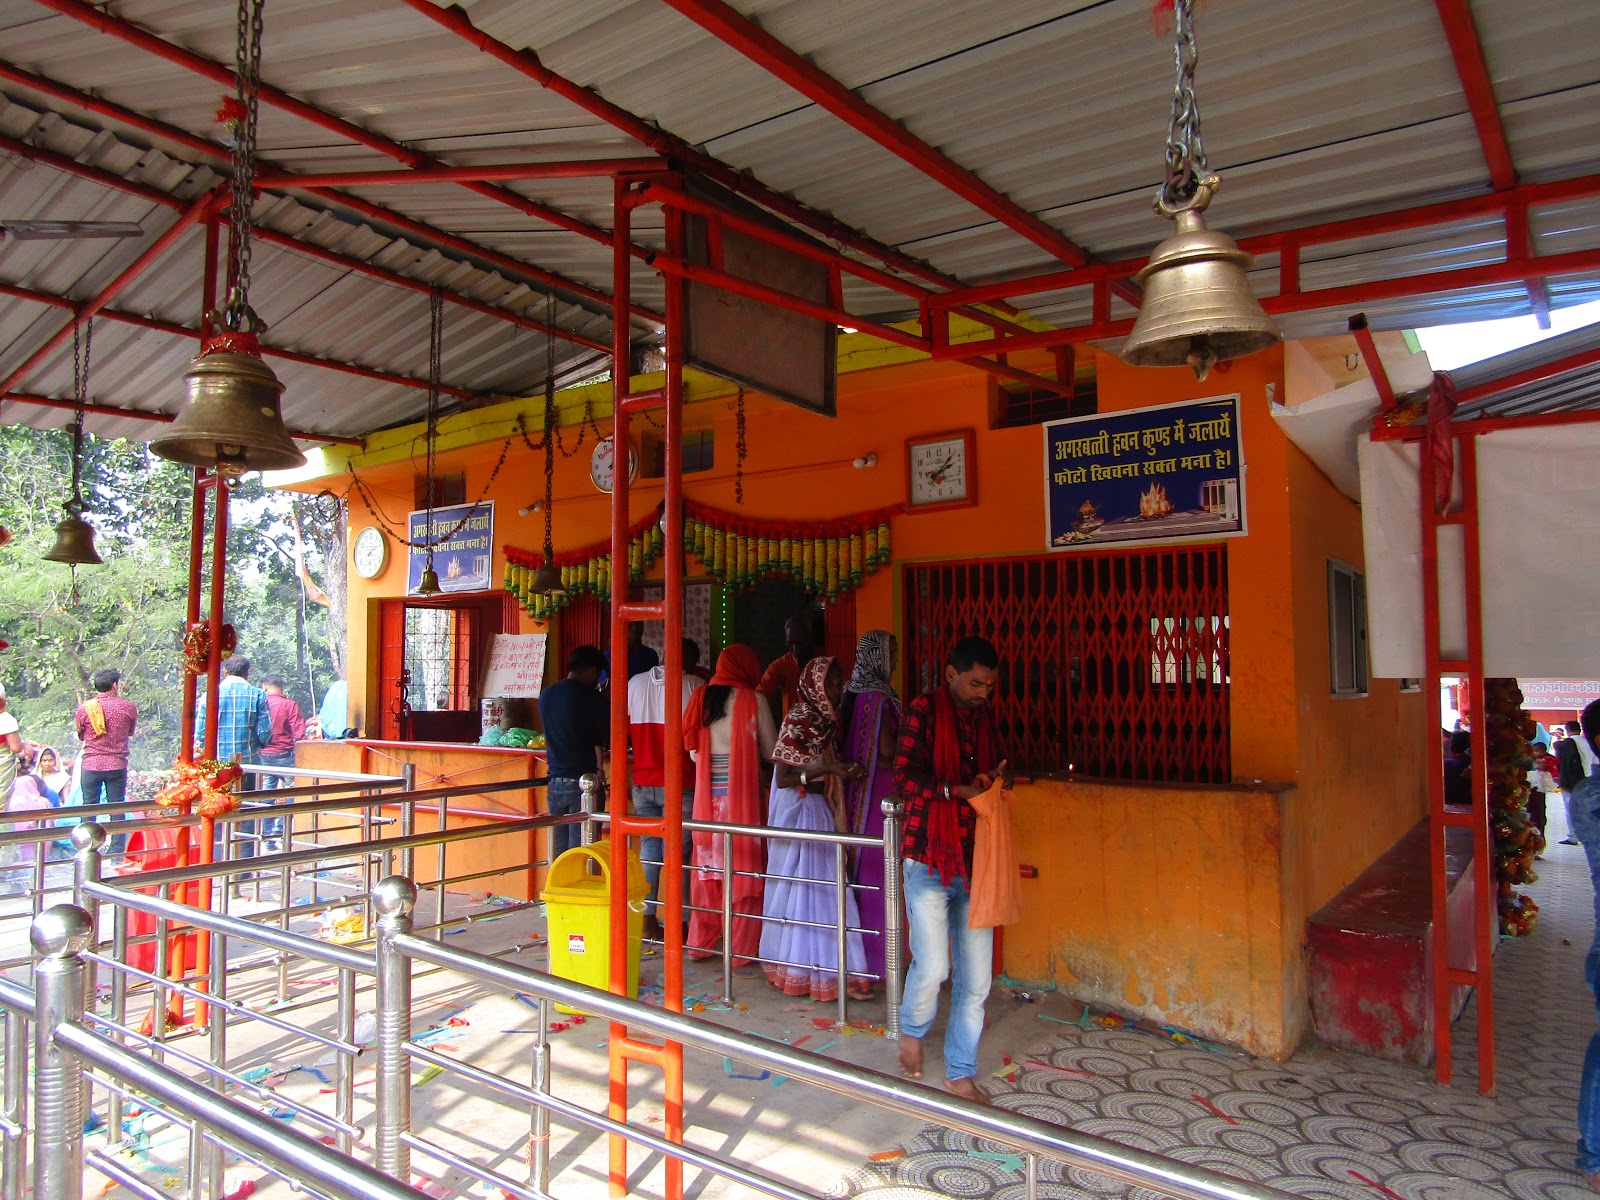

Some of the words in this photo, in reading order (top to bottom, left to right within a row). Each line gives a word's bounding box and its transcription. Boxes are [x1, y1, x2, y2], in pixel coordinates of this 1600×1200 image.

[1055, 430, 1110, 460] अगरबत्ती
[1112, 431, 1140, 457] हवन
[1142, 426, 1170, 456] कुण्ड
[1174, 418, 1185, 444] में
[1188, 412, 1231, 442] जलायें
[1054, 467, 1087, 486] फोटो
[1142, 458, 1177, 476] सक्त
[1180, 453, 1211, 470] मना
